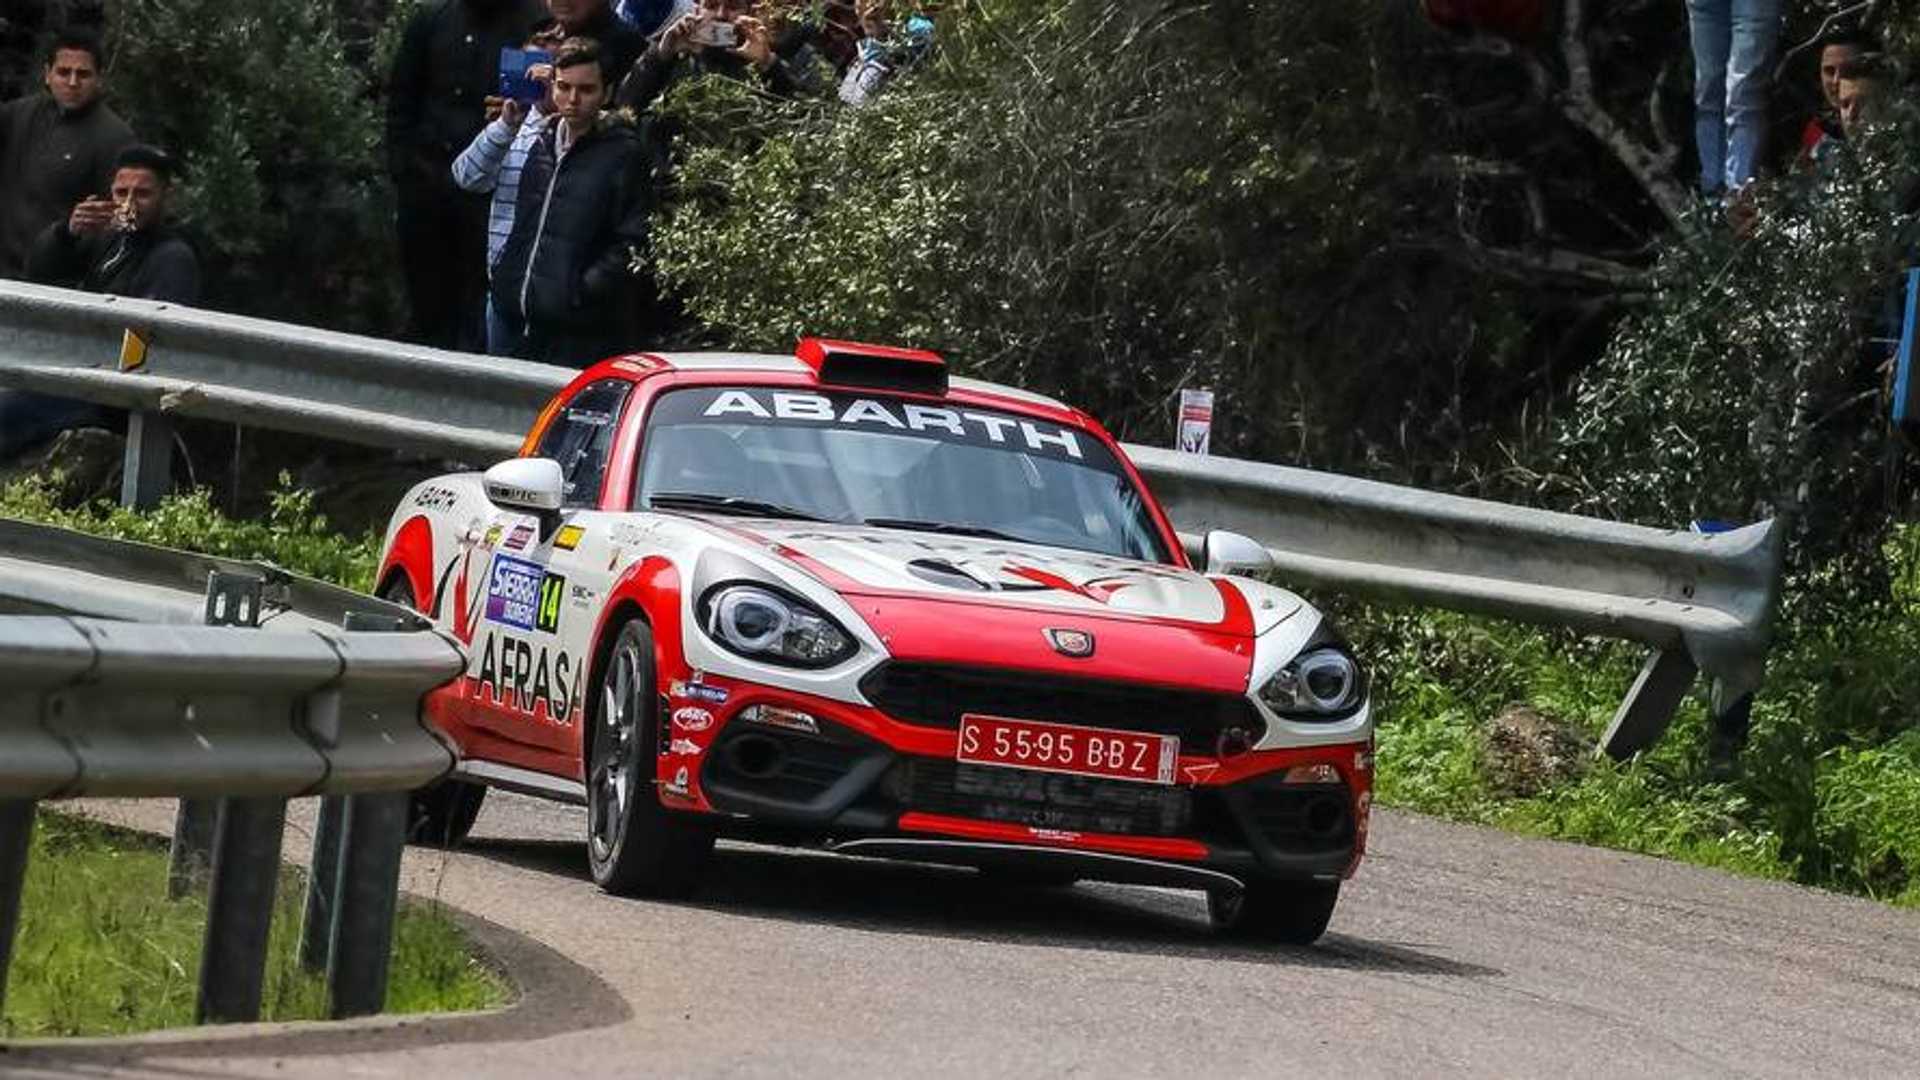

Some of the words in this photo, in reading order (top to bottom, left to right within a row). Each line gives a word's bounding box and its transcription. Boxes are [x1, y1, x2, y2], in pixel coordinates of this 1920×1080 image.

[703, 390, 1083, 459] ABARTH
[490, 560, 540, 606] SIERRA
[539, 577, 561, 627] 14
[477, 631, 582, 723] AFRASA
[963, 725, 980, 753] S
